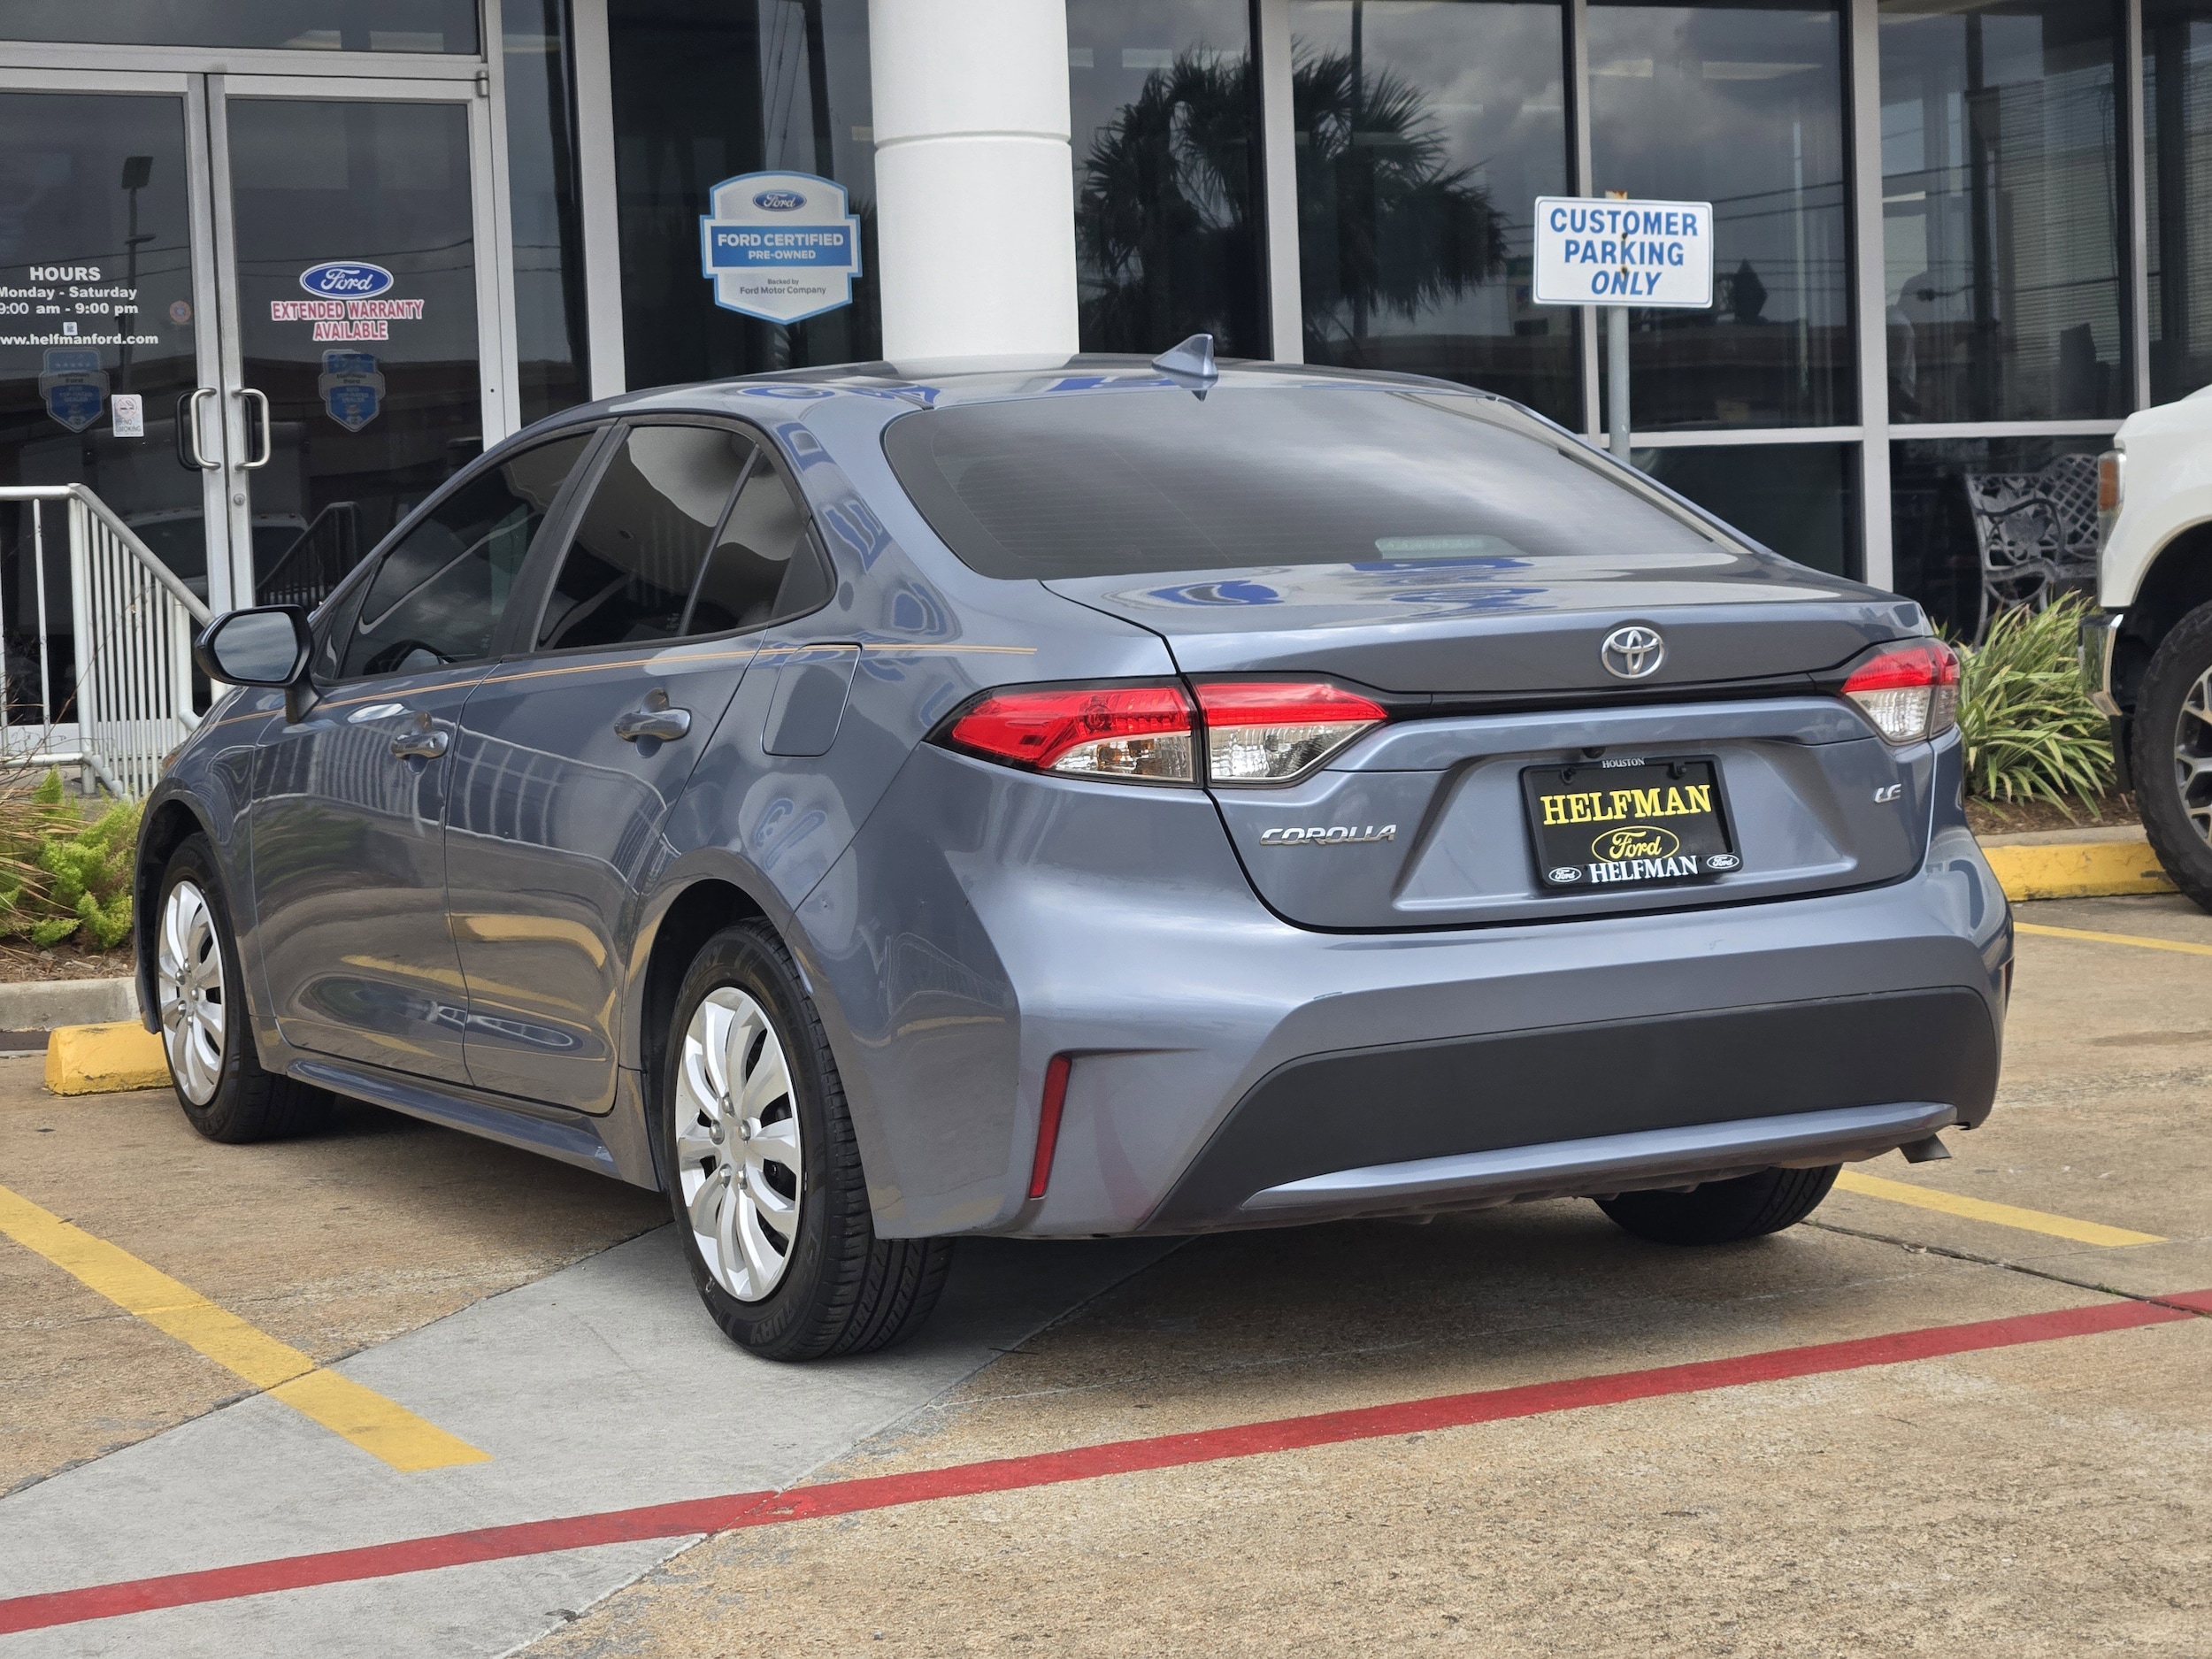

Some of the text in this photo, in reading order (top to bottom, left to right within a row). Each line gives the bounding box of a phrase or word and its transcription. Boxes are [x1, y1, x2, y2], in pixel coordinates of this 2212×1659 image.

[763, 193, 795, 208] Ford
[1550, 208, 1699, 236] CUSTOMER
[718, 233, 844, 247] FORD CERTIFIED
[748, 250, 816, 260] PRE-OWNED
[1564, 239, 1684, 266] PARKING
[29, 266, 101, 281] HOURS
[320, 268, 373, 291] Ford
[1591, 270, 1663, 296] ONLY
[0, 286, 55, 300] Monday
[69, 286, 137, 300] Saturday
[740, 286, 826, 296] Ford Motor Company
[0, 302, 29, 315] 9:00
[35, 304, 61, 314] am
[74, 303, 109, 315] 9:00
[114, 304, 138, 316] pm
[272, 300, 424, 320] EXTENDED WARRANTY
[313, 321, 388, 341] AVAILABLE
[1602, 757, 1645, 769] HOUSTON
[1874, 783, 1901, 803] LE
[1540, 784, 1712, 825] HELFMAN
[1259, 824, 1396, 846] COROLLA
[1609, 831, 1663, 859] Ford
[1588, 856, 1700, 883] HELFMAN
